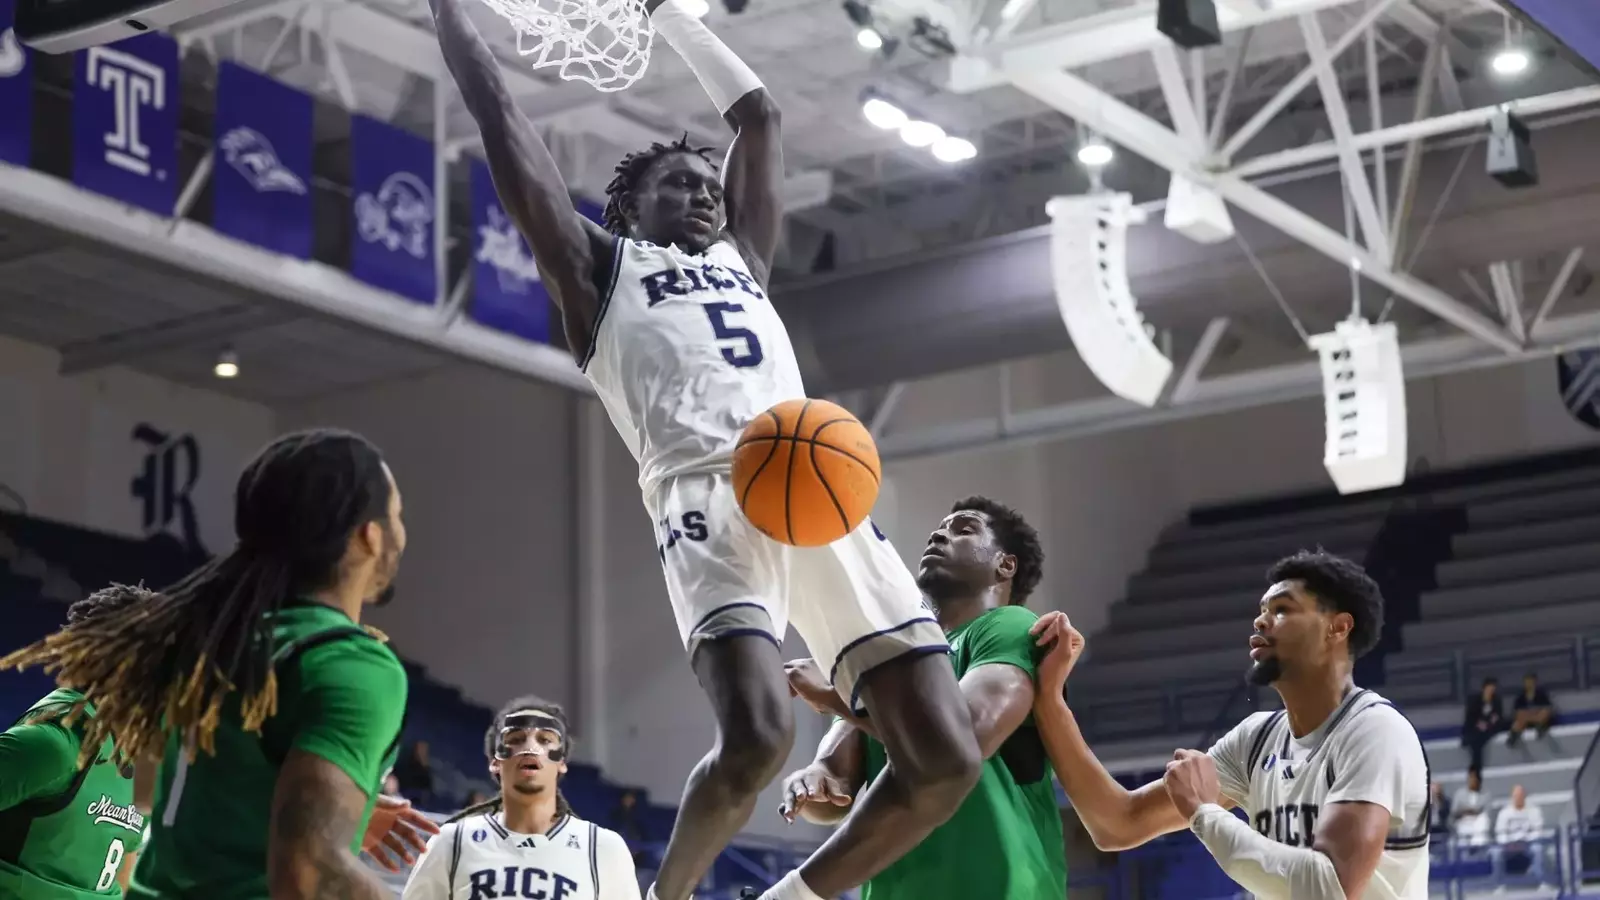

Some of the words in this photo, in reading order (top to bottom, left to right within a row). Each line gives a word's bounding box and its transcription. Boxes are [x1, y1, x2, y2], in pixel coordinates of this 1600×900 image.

[640, 264, 764, 308] RICE
[703, 302, 763, 368] 5
[87, 794, 127, 821] Mean
[95, 838, 124, 892] 8
[468, 866, 578, 900] RICE
